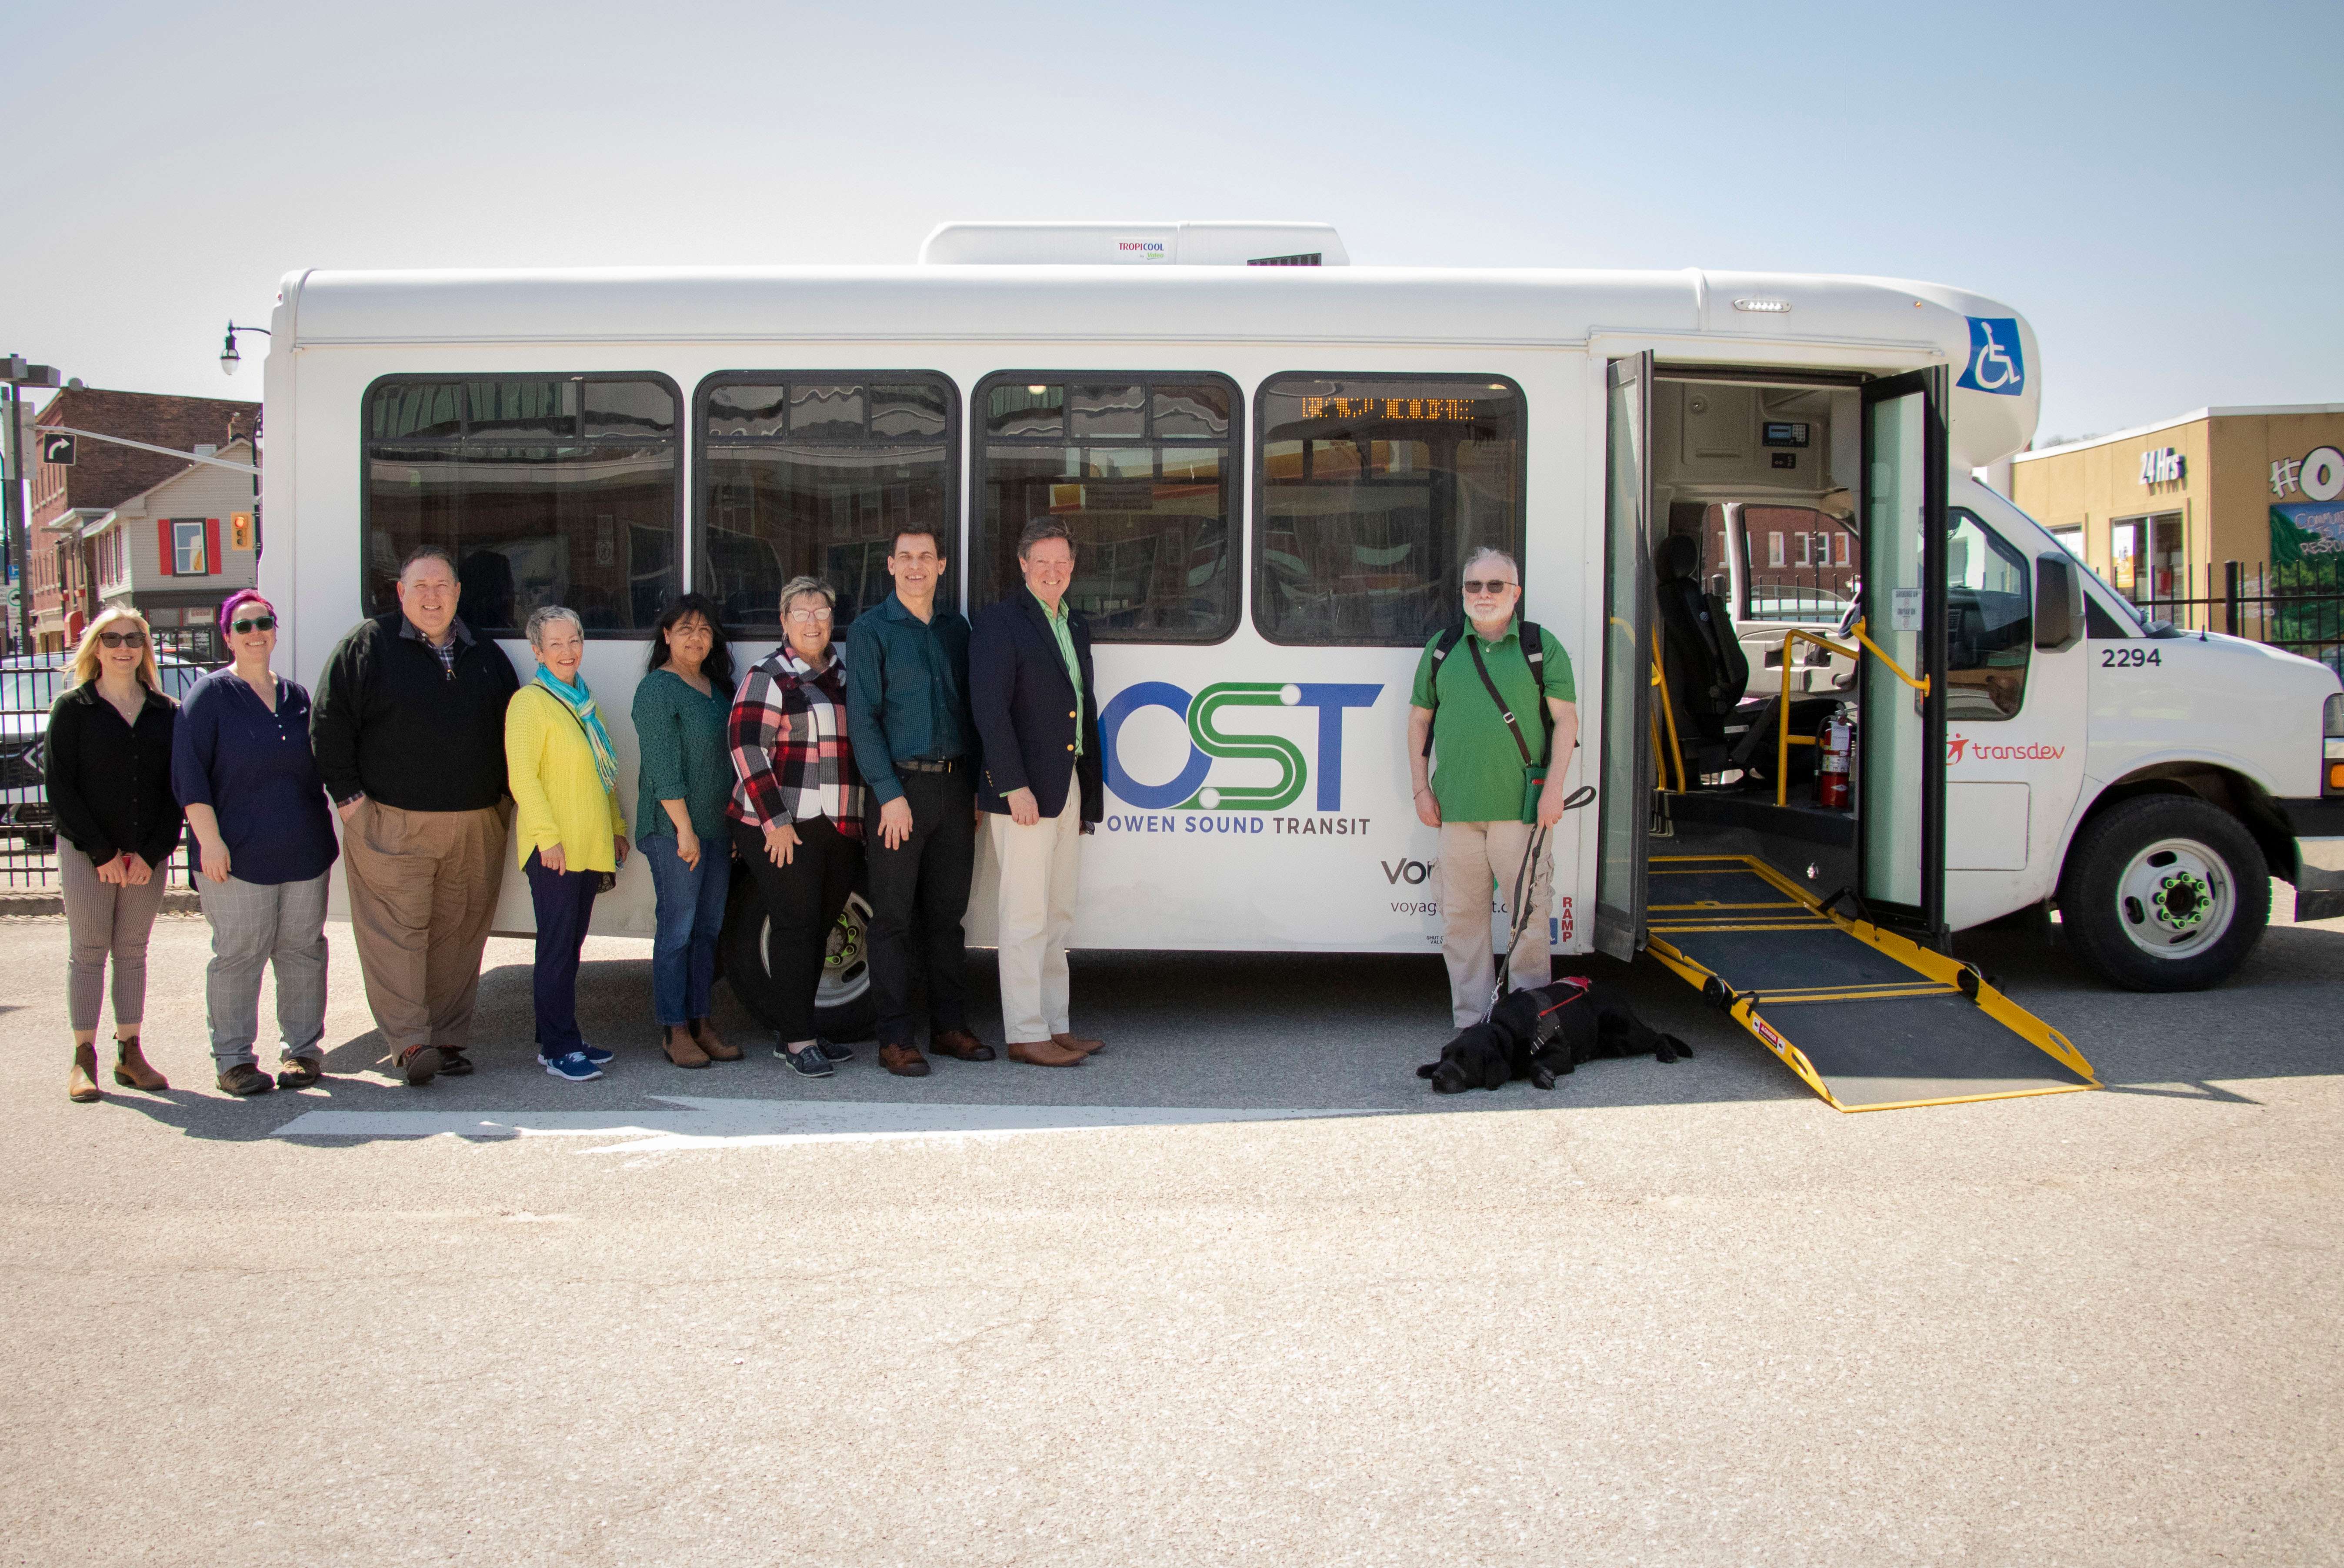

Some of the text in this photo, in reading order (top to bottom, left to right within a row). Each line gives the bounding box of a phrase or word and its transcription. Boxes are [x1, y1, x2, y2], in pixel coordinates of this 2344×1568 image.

[1119, 243, 1164, 251] TROPICOOL
[2138, 447, 2184, 485] 24 Hrs
[2102, 648, 2162, 667] 2294
[1097, 681, 1385, 812] OST
[1972, 742, 2065, 760] transdev
[1107, 815, 1370, 835] OWEN SOUND TRANSIT
[1390, 902, 1437, 916] voyag
[1561, 897, 1573, 942] RAMP
